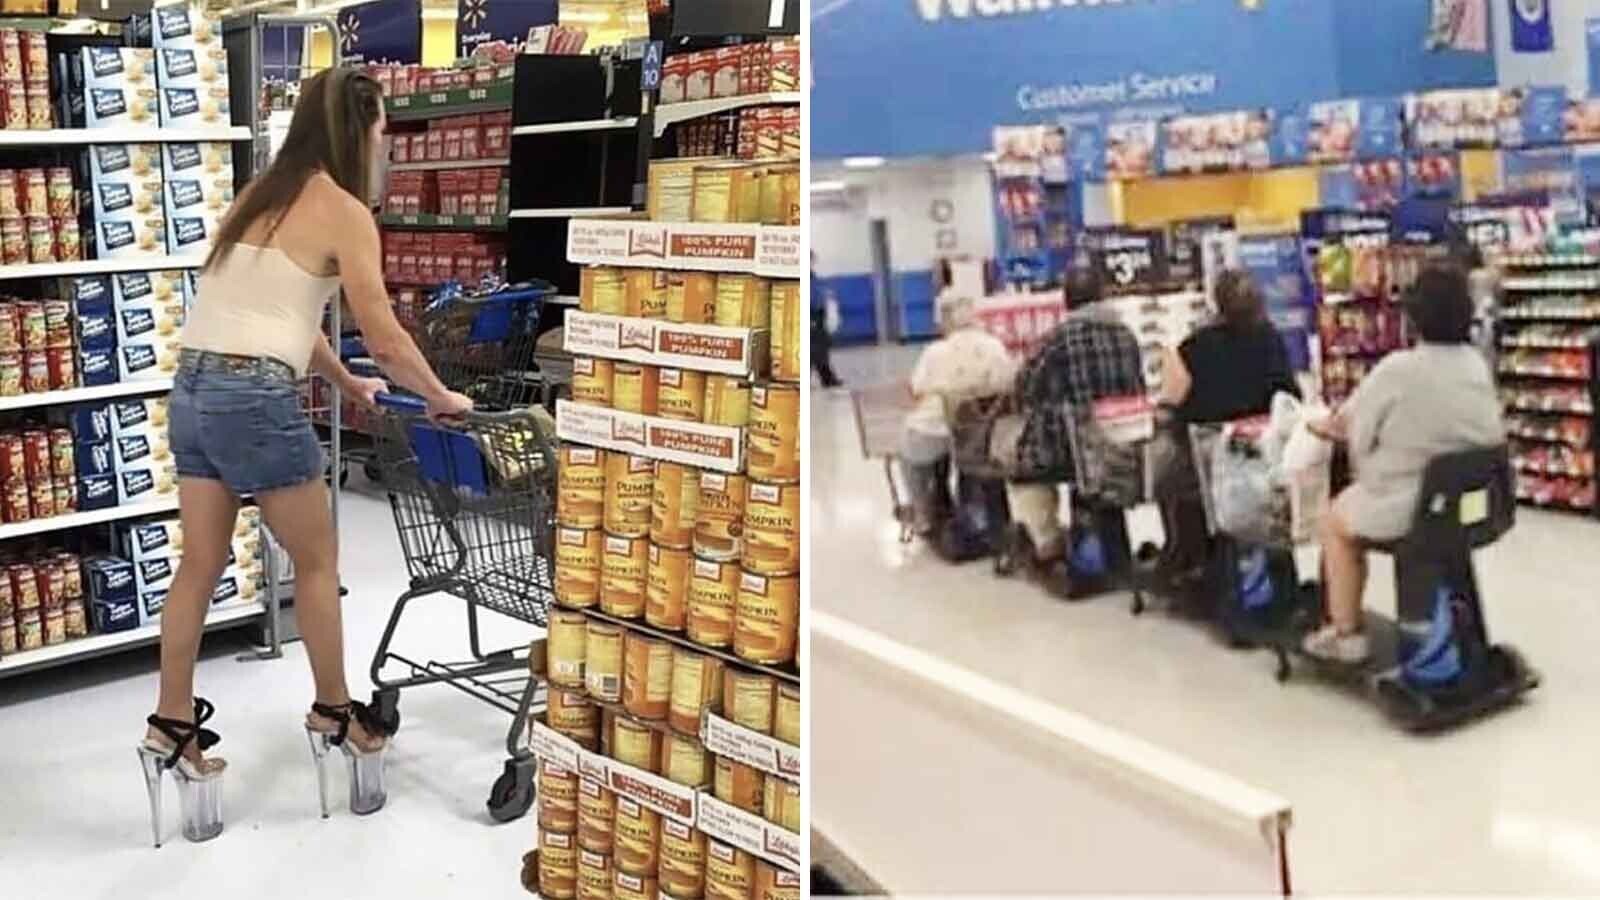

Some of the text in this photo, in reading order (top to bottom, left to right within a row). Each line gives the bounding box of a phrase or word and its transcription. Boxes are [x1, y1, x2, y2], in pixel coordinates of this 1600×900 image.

[646, 45, 658, 63] A
[643, 69, 659, 86] 10
[1016, 82, 1126, 111] Customer
[715, 236, 750, 248] PURE
[684, 247, 744, 258] PUMPKIN
